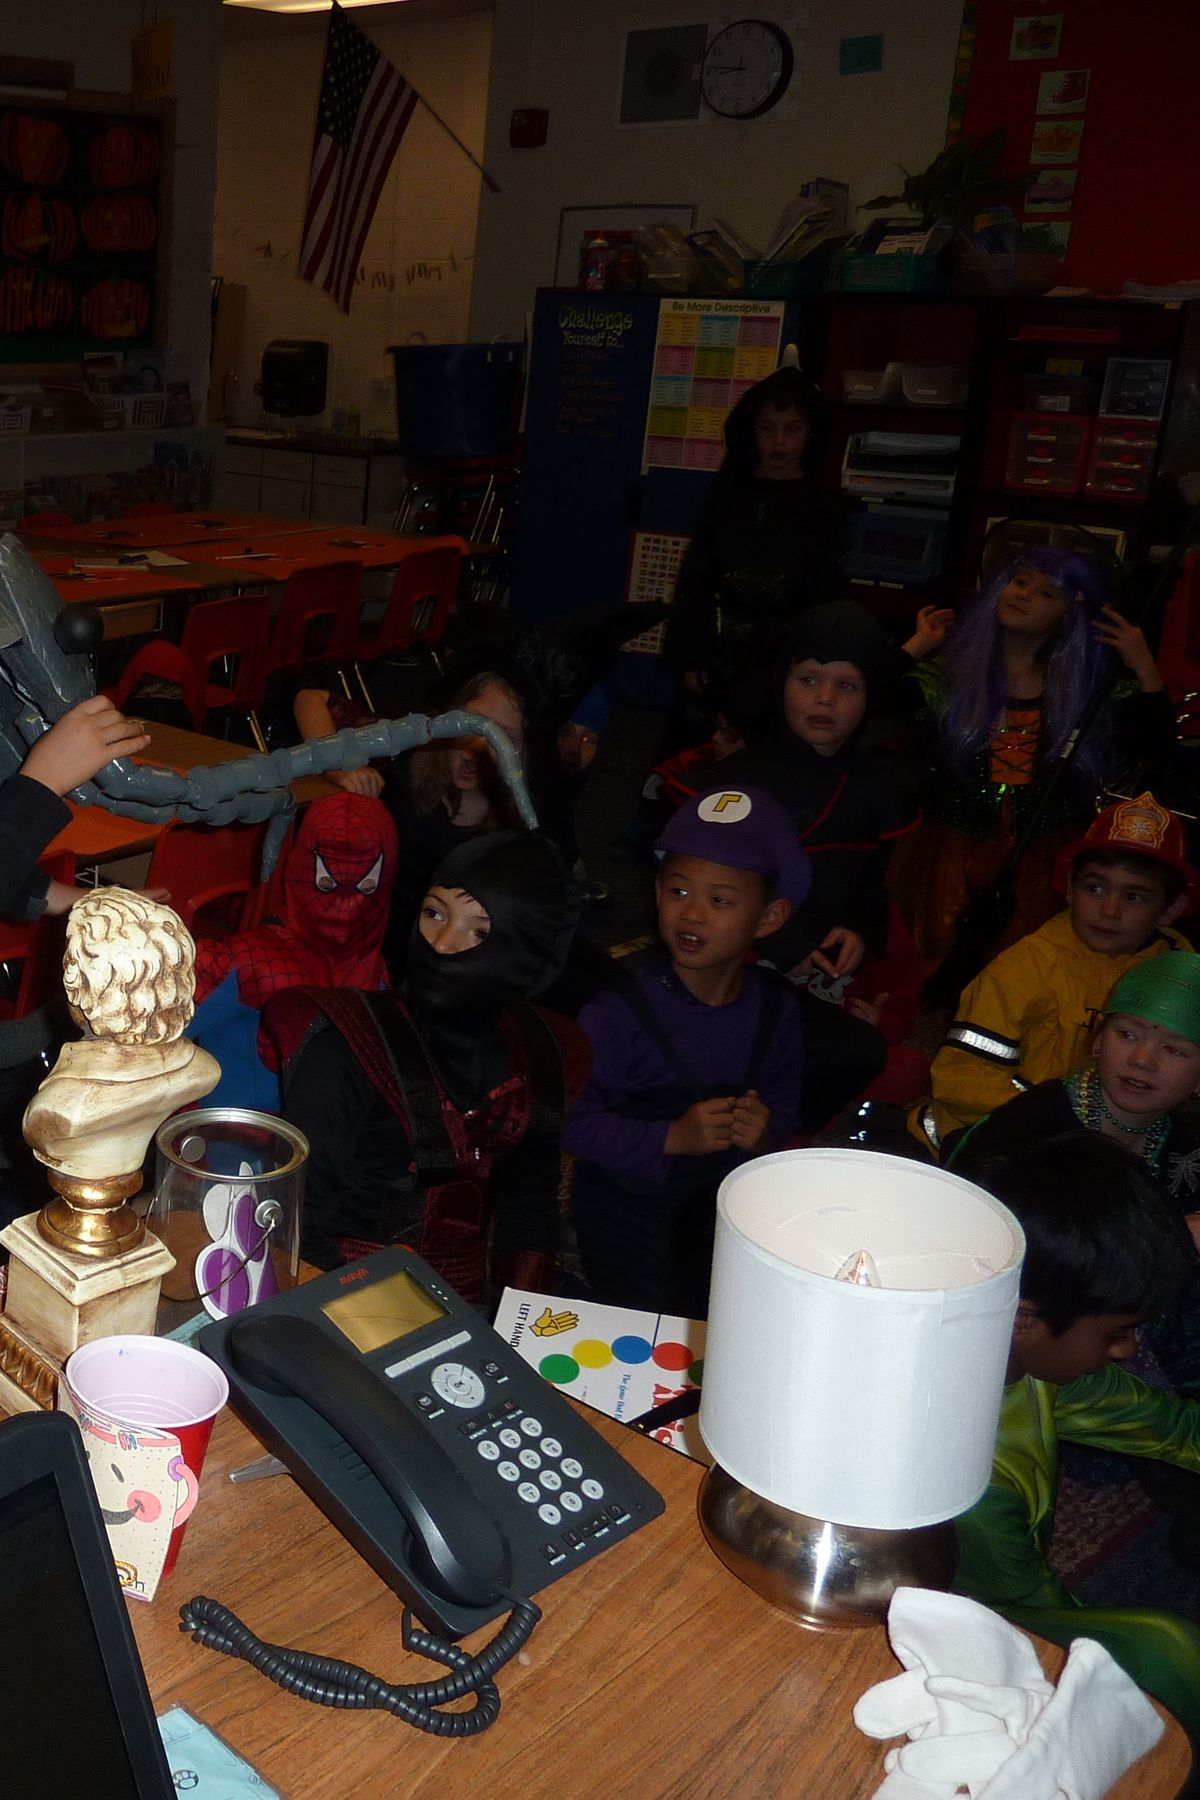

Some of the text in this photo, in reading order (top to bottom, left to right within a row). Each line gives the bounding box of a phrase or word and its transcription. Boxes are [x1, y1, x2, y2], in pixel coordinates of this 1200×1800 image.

[672, 302, 770, 314] Be More Descriptive
[558, 304, 635, 336] Challenge
[510, 1303, 531, 1348] LEFT HAND
[453, 1380, 465, 1389] OK
[622, 1374, 631, 1385] The
